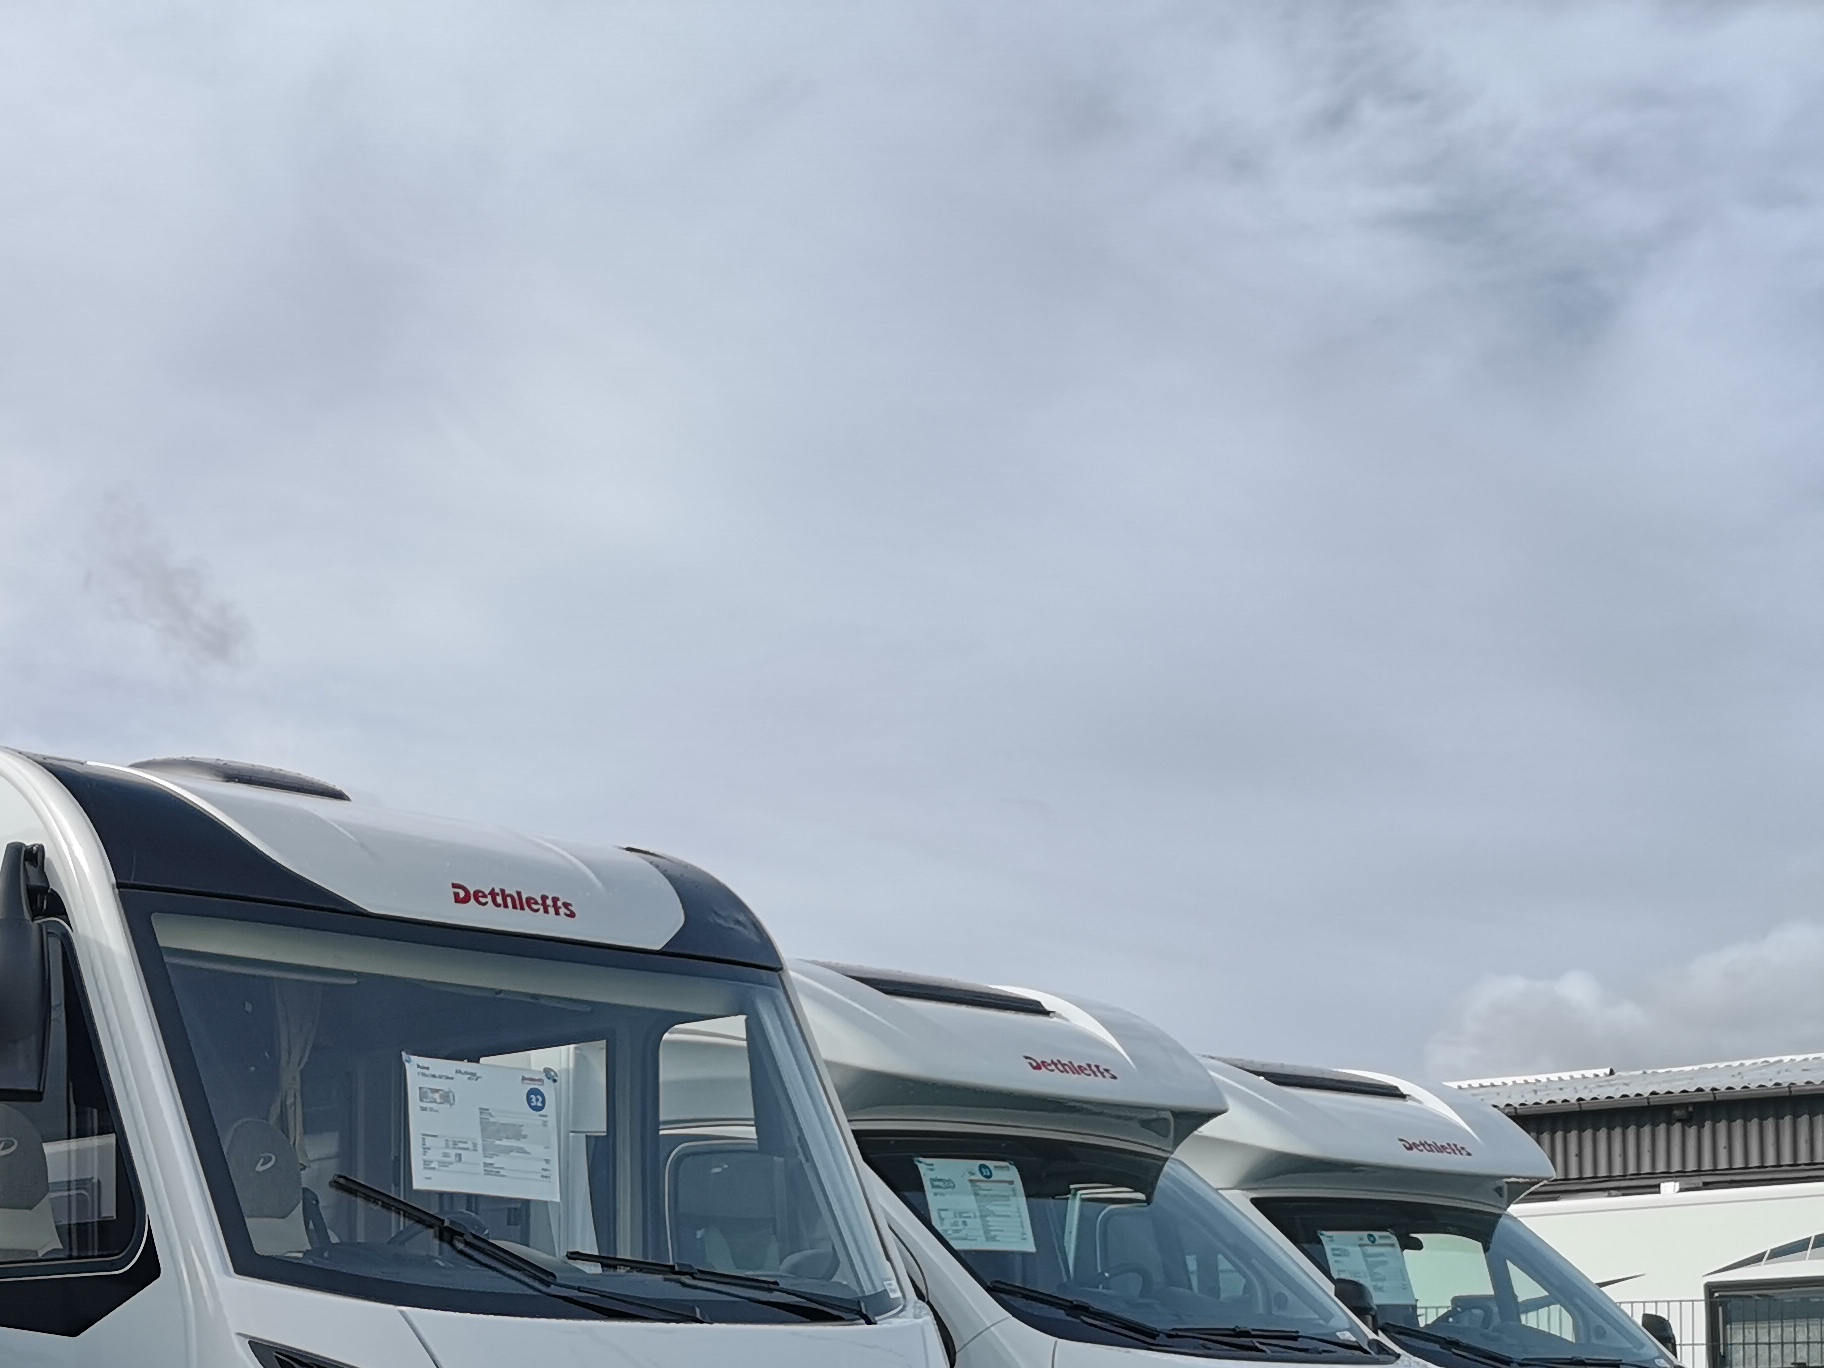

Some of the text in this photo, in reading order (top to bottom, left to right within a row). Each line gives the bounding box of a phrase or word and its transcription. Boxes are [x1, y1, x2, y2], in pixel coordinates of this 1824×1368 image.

[450, 881, 577, 919] Dethleffs
[1022, 1054, 1118, 1081] Dethleffs
[528, 1093, 544, 1107] 32
[1397, 1136, 1473, 1157] Dethleffs
